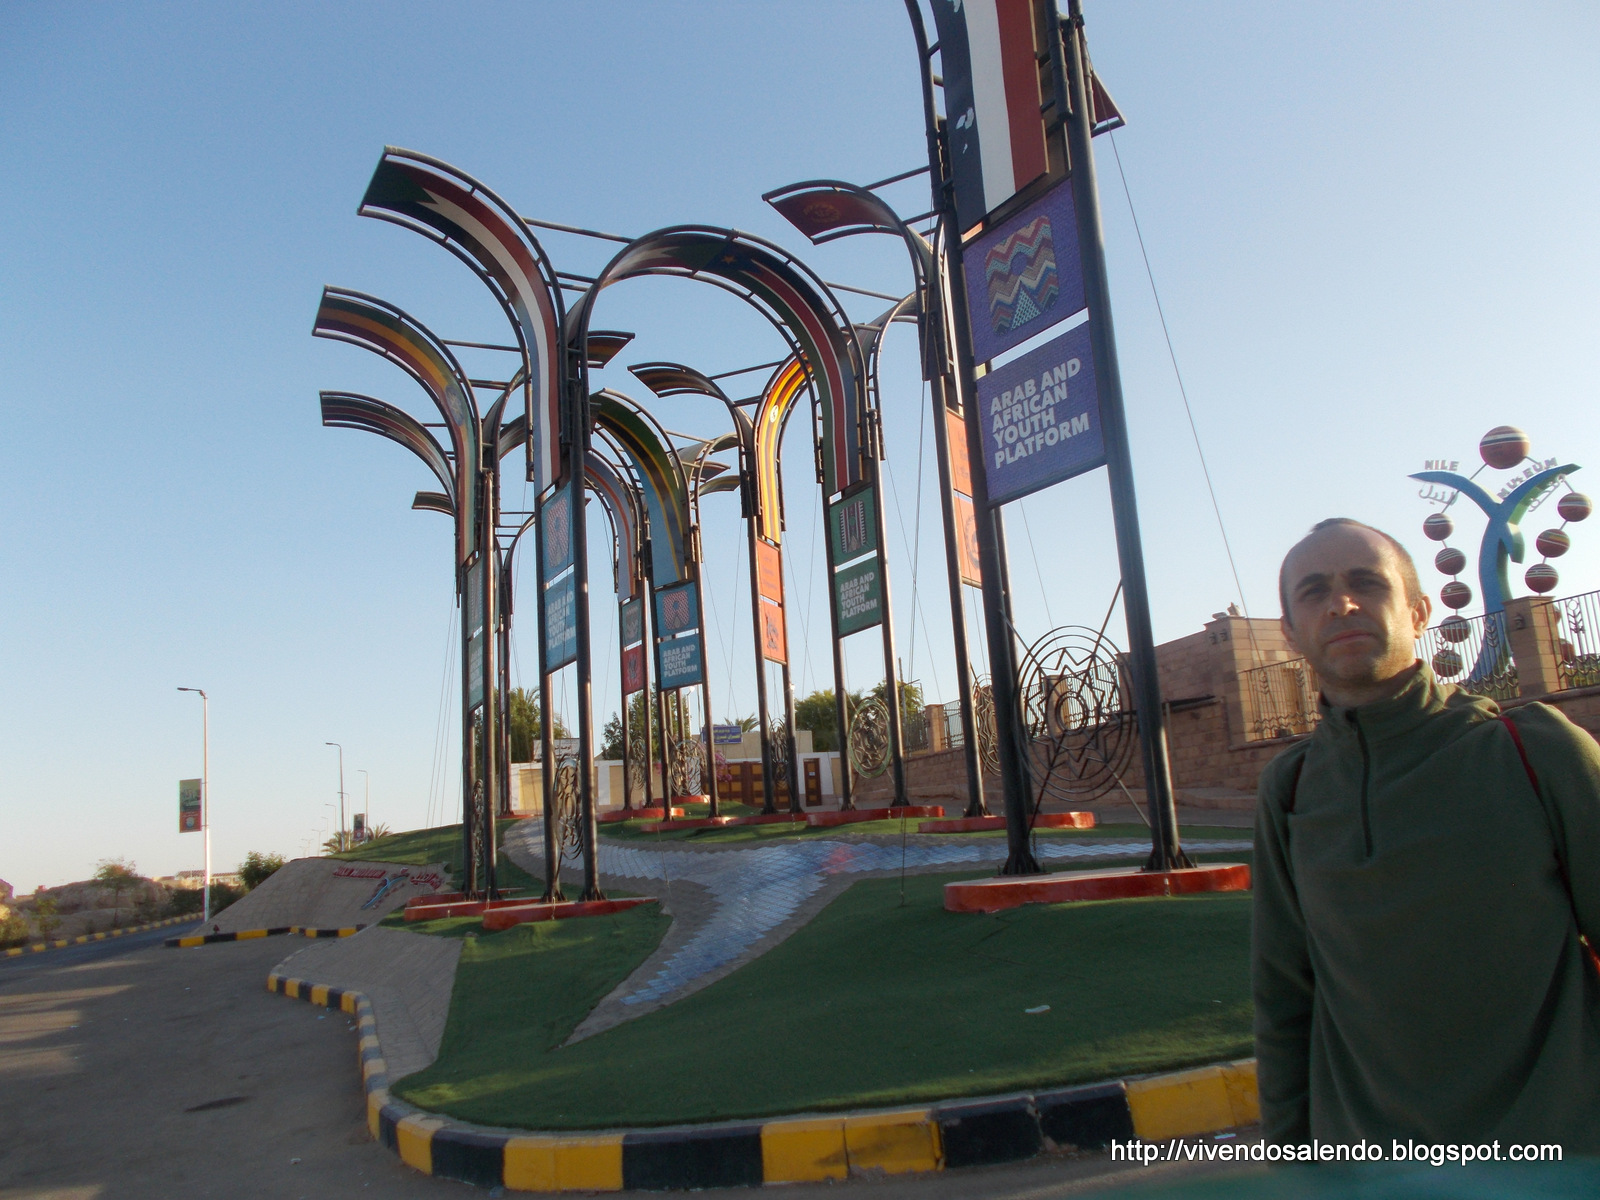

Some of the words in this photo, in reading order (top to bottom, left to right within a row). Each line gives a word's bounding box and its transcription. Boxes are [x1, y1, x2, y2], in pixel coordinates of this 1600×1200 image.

[990, 378, 1037, 416] ARAB
[1041, 358, 1081, 391] AND
[992, 381, 1068, 433] AFRICAN
[993, 407, 1056, 449] YOUTH
[994, 412, 1090, 470] PLATFORM
[1424, 460, 1459, 471] NILE
[1497, 457, 1558, 499] MUSEUM
[840, 578, 859, 593] ARAB
[859, 571, 875, 585] AND
[841, 582, 870, 601] AFRICAN
[841, 593, 865, 610] YOUTH
[841, 598, 878, 620] PLATFORM
[663, 648, 681, 658] ARAB
[681, 644, 696, 653] AND
[663, 652, 691, 664] AFRICAN
[664, 660, 687, 670] YOUTH
[664, 664, 698, 678] PLATFORM
